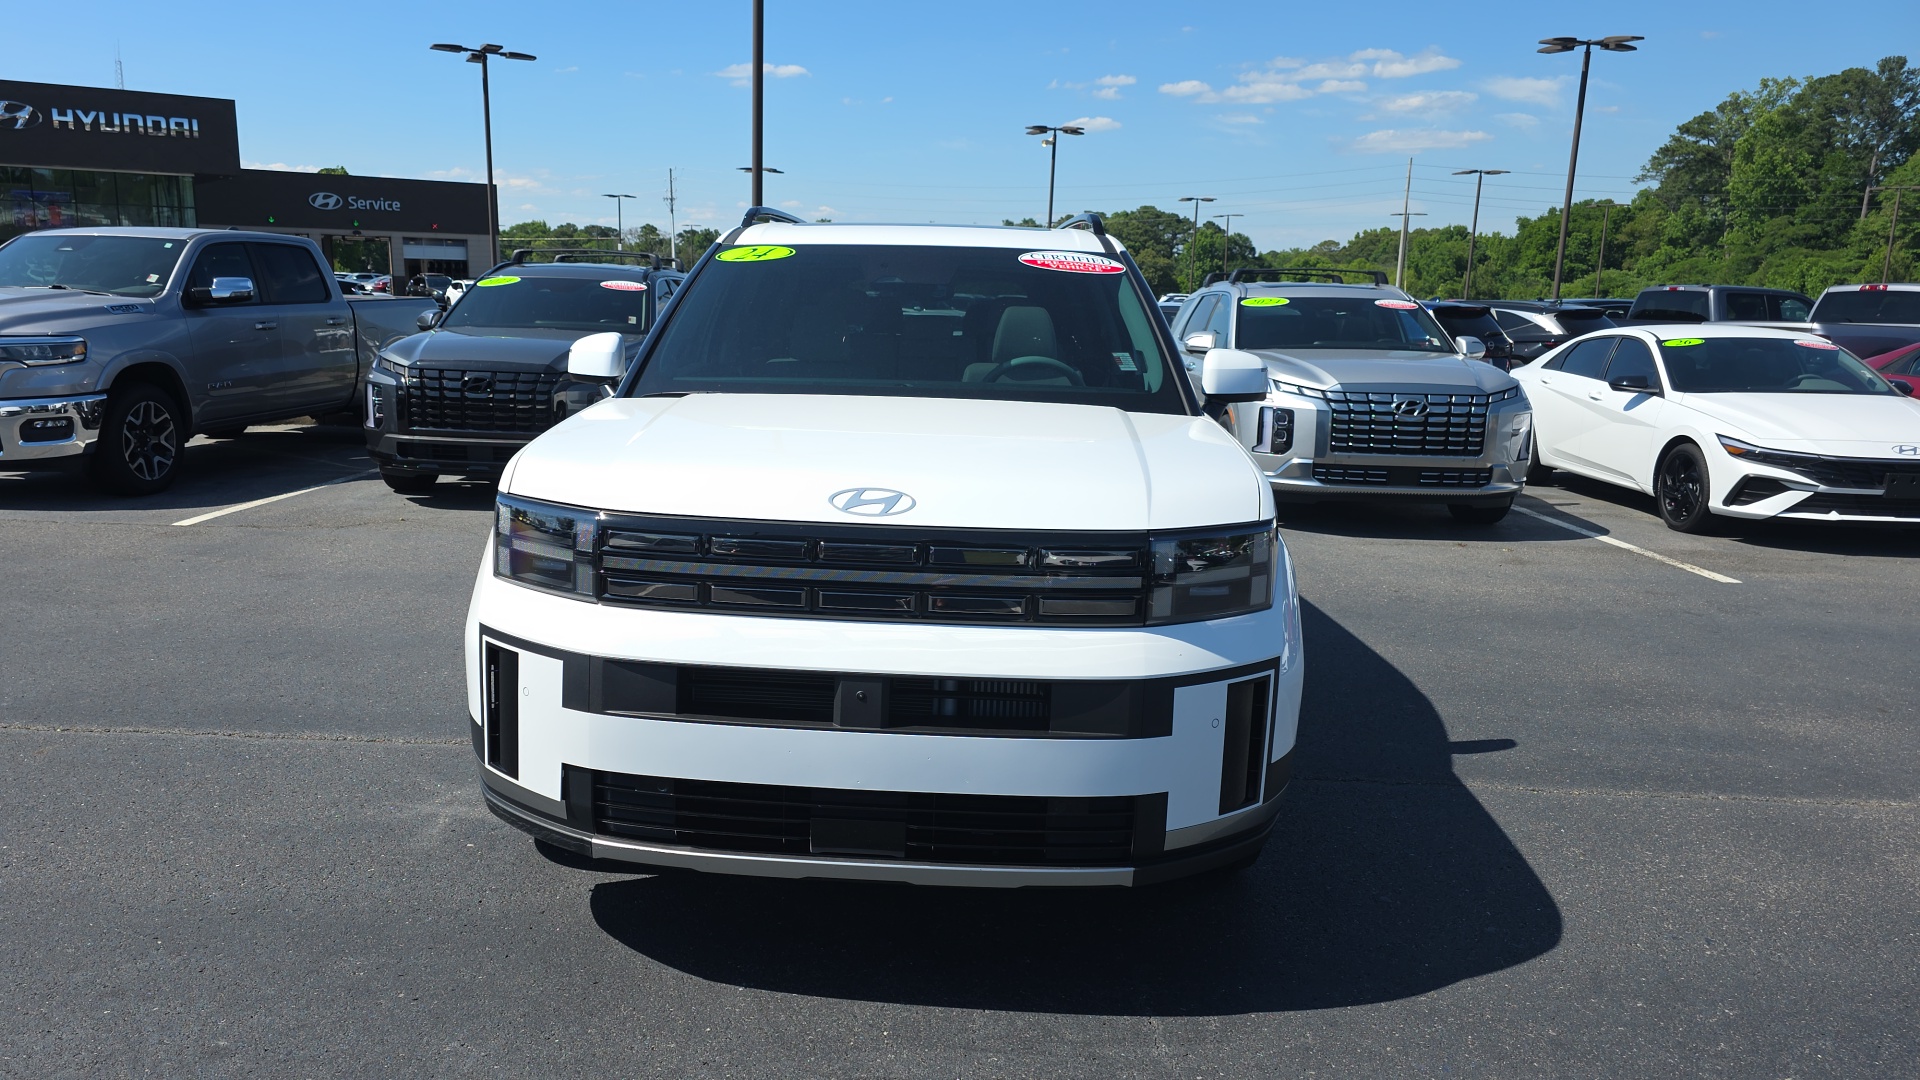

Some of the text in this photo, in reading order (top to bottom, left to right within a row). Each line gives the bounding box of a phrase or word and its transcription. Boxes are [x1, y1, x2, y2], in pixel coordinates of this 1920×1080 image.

[51, 107, 200, 139] HYUNDAI
[347, 196, 401, 211] Service
[732, 247, 778, 261] 24
[1029, 252, 1112, 266] CERTIFIED
[1036, 259, 1112, 270] PRE-OWNED
[1049, 264, 1104, 272] VEHICLE
